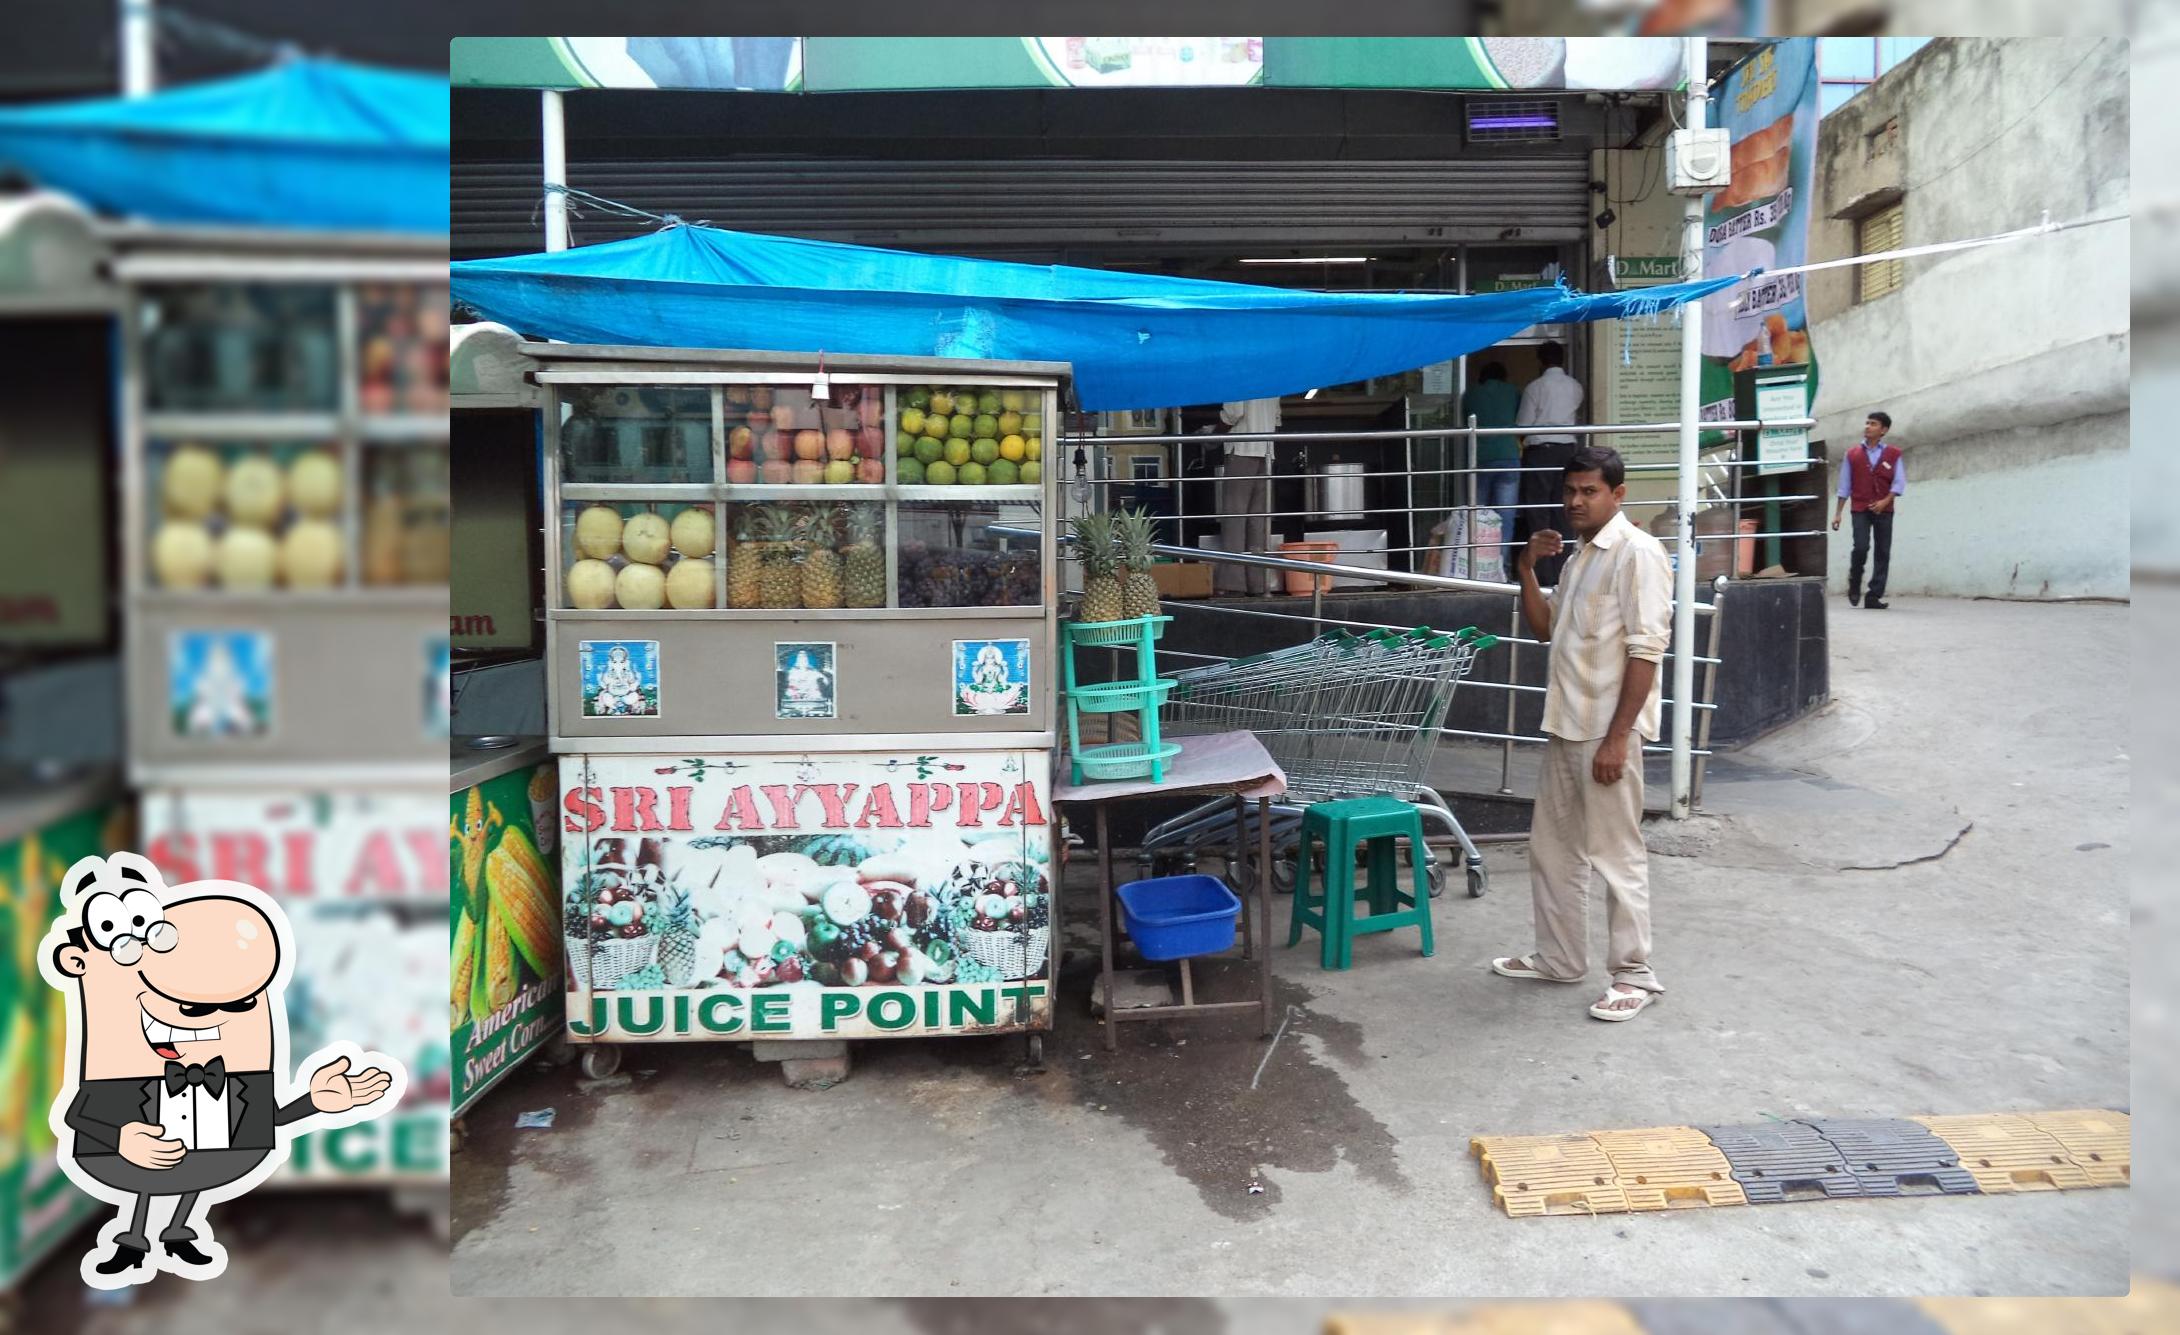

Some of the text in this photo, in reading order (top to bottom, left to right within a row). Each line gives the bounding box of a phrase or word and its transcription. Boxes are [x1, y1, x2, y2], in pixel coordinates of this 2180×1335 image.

[564, 786, 694, 832] SRI
[714, 780, 1048, 831] AYYAPPA
[465, 974, 559, 1055] American
[568, 985, 1046, 1037] JUICE POINT
[463, 1038, 507, 1093] Sweet
